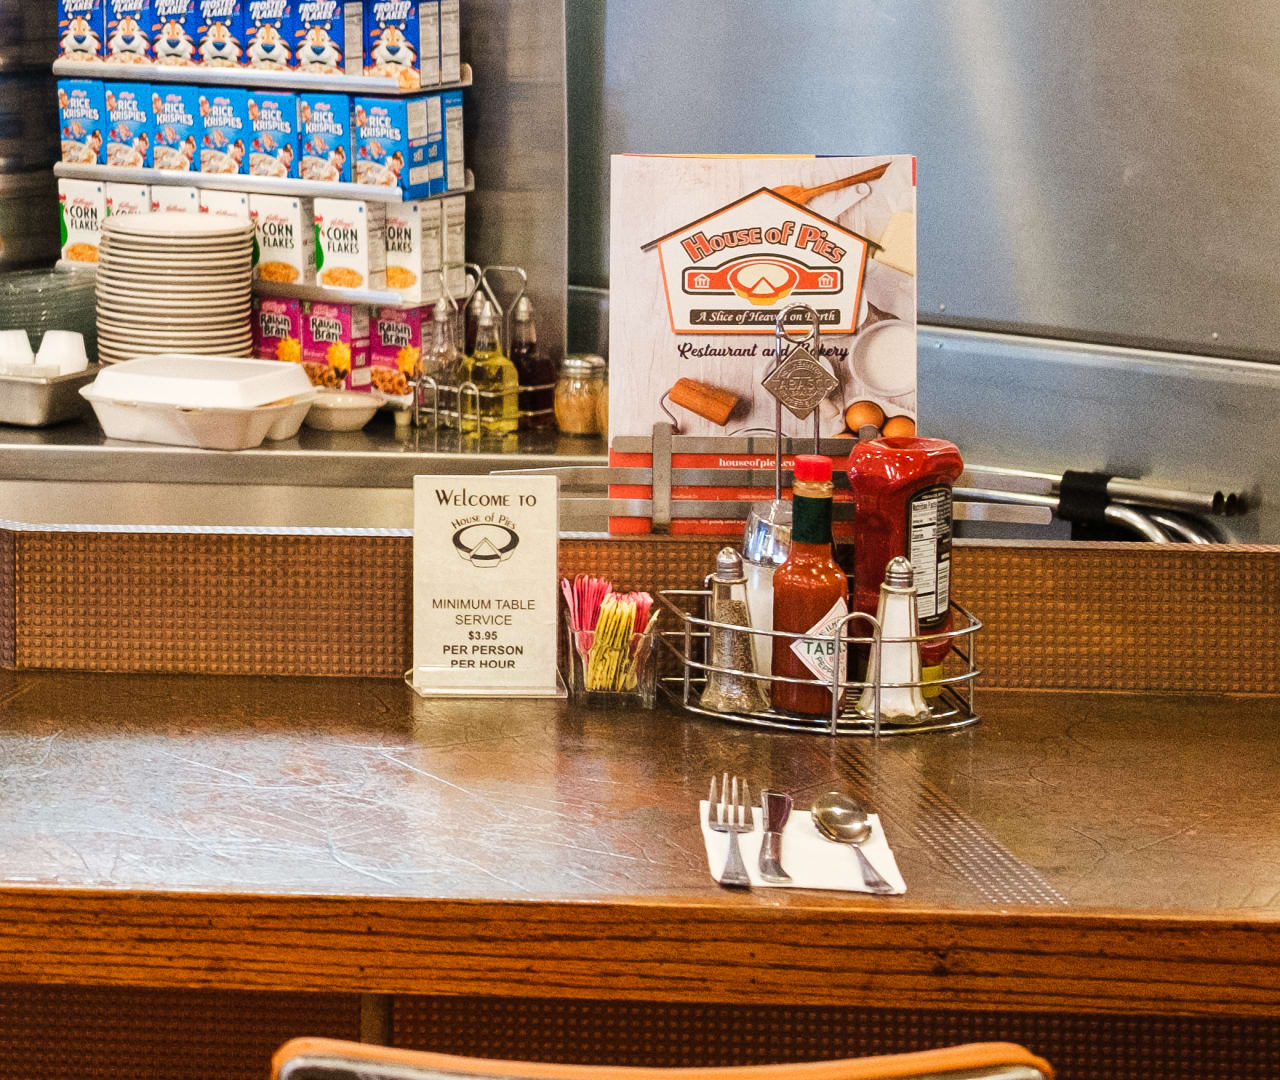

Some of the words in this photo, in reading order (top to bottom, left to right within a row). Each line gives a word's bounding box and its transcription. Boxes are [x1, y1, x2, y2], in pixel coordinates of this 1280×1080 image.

[70, 98, 90, 108] RICE
[117, 100, 137, 110] RICE
[164, 103, 184, 113] RICE
[63, 107, 99, 121] KRISPIES
[110, 110, 147, 123] KRISPIES
[212, 106, 233, 117] RICE
[261, 110, 282, 121] RICE
[313, 111, 333, 122] RICE
[156, 113, 193, 126] KRISPIES
[204, 116, 242, 129] KRISPIES
[369, 116, 391, 127] RICE
[253, 120, 291, 133] KRISPIES
[305, 122, 343, 136] KRISPIES
[360, 126, 401, 141] KRISPIES
[69, 205, 98, 219] CORN
[70, 219, 99, 231] FLAKES
[262, 222, 293, 236] CORN
[327, 227, 358, 241] CORN
[388, 228, 411, 241] ORN
[765, 220, 796, 245] of
[263, 236, 295, 249] FLAKES
[327, 241, 359, 254] FLAKES
[386, 239, 412, 253] LAKES
[696, 310, 707, 322] A
[708, 310, 733, 322] Slice
[735, 310, 748, 325] of
[748, 310, 787, 322] Heavn
[264, 324, 287, 337] Bran
[311, 317, 341, 332] Raisin
[379, 321, 410, 337] Raisin
[314, 329, 339, 342] Bran
[383, 333, 407, 346] Bran
[677, 341, 757, 359] Restaurant
[719, 458, 796, 470] houseofpie.co
[435, 488, 510, 507] Welcome
[484, 512, 495, 523] of
[432, 598, 491, 610] MINIMUM
[496, 599, 536, 610] TABLE
[455, 614, 513, 625] SERVICE
[468, 630, 498, 640] $3.95
[443, 645, 468, 655] PER
[472, 645, 524, 655] PERSON
[451, 659, 476, 668] PER
[480, 659, 516, 669] HOUR
